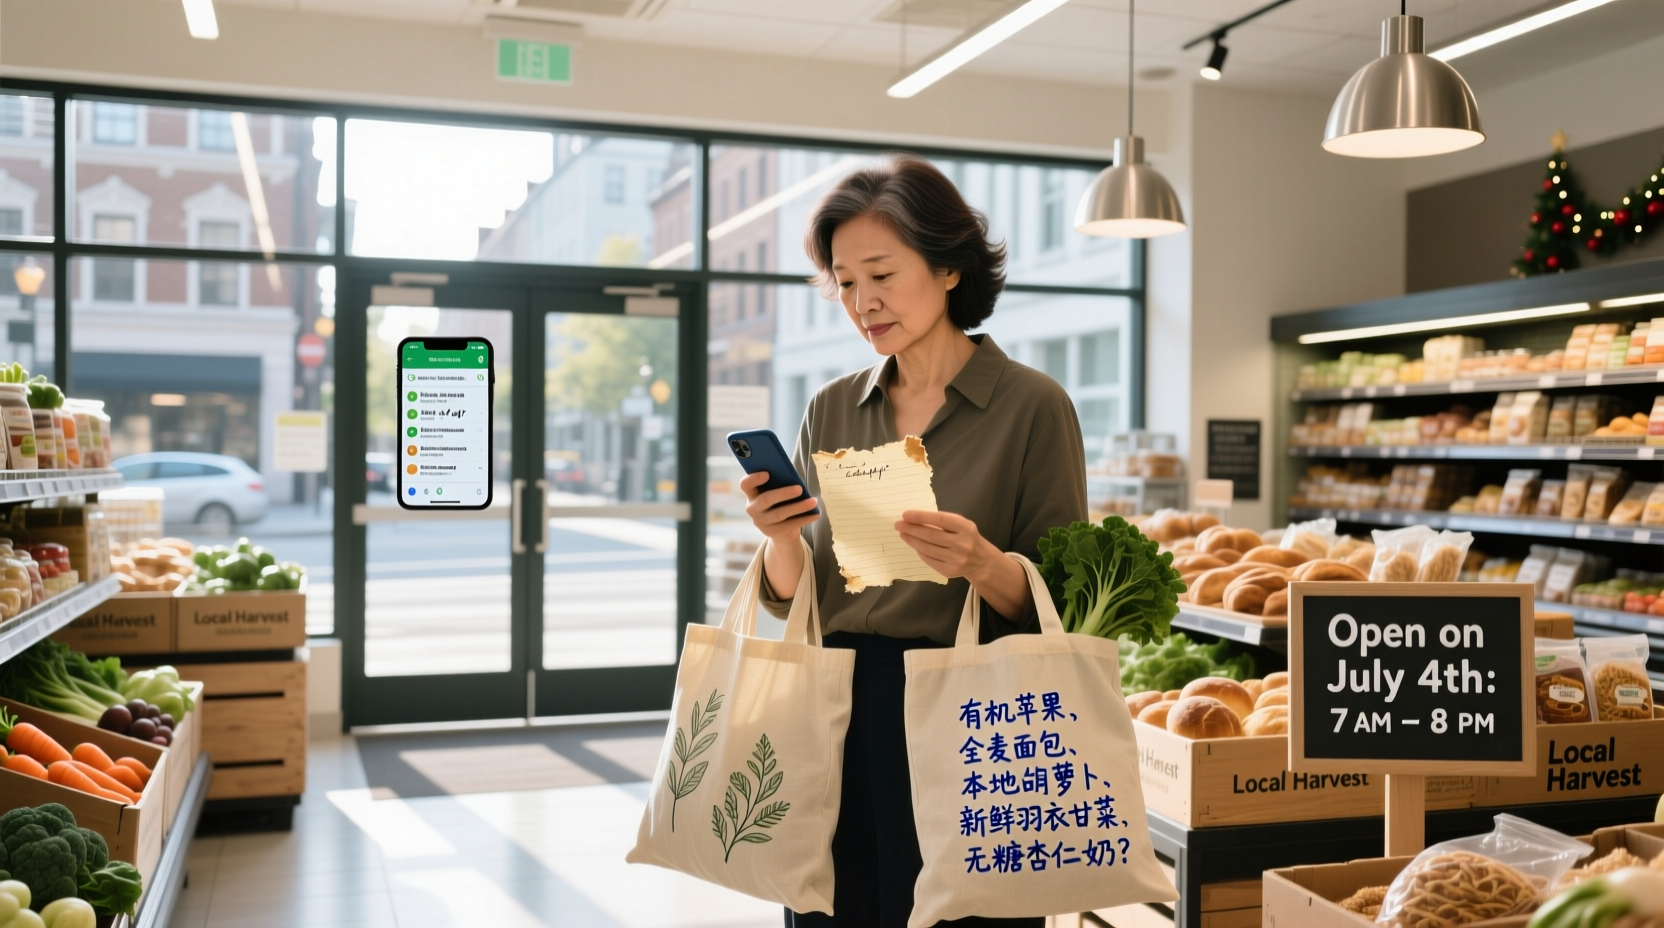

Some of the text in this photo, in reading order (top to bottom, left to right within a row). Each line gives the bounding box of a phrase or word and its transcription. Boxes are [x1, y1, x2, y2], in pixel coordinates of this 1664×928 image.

[193, 609, 290, 625] Local Harvest
[1328, 613, 1484, 657] Open on
[1327, 658, 1496, 703] July 4th:
[1330, 708, 1349, 733] 7
[1353, 711, 1392, 734] AM
[1430, 708, 1448, 734] 8
[1458, 712, 1494, 734] PM
[1548, 736, 1616, 765] Local
[1233, 770, 1370, 794] Local Harvest
[1546, 763, 1642, 792] Harvest
